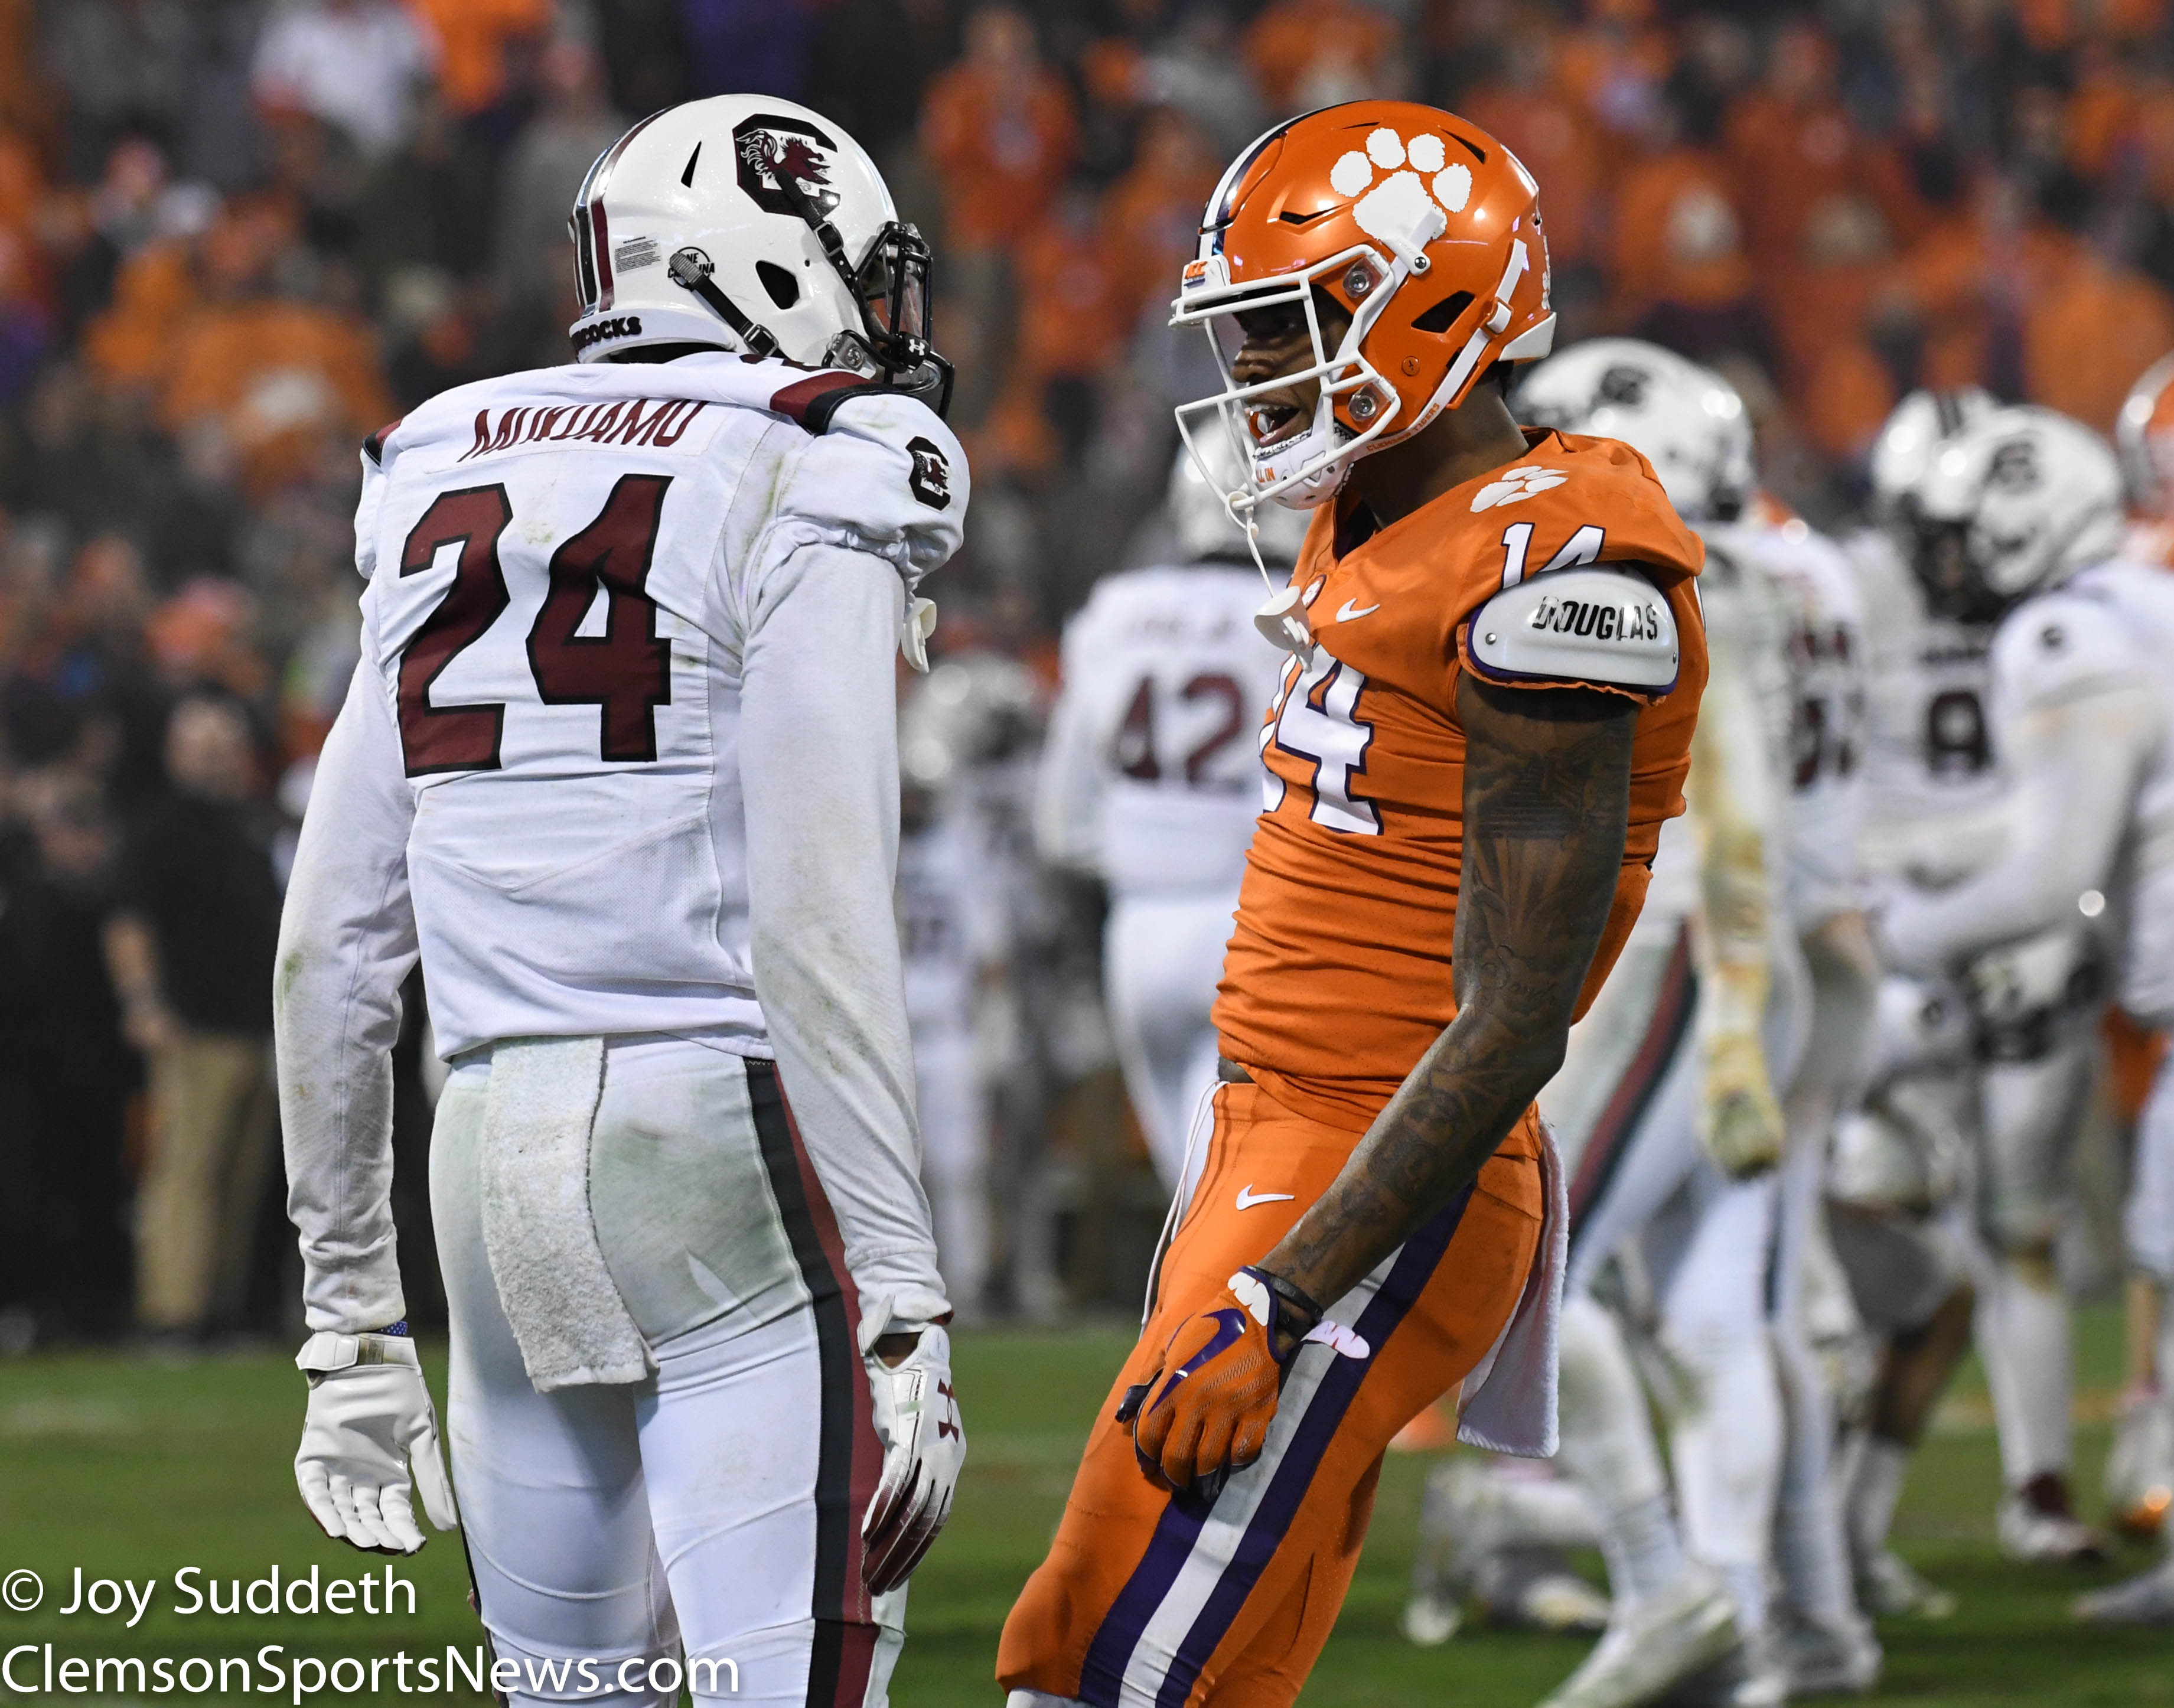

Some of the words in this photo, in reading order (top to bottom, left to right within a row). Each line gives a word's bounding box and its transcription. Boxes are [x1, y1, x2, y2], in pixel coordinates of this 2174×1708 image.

[397, 473, 674, 778] 24
[1532, 595, 1658, 641] DOUGLAS
[1109, 670, 1247, 788] 42
